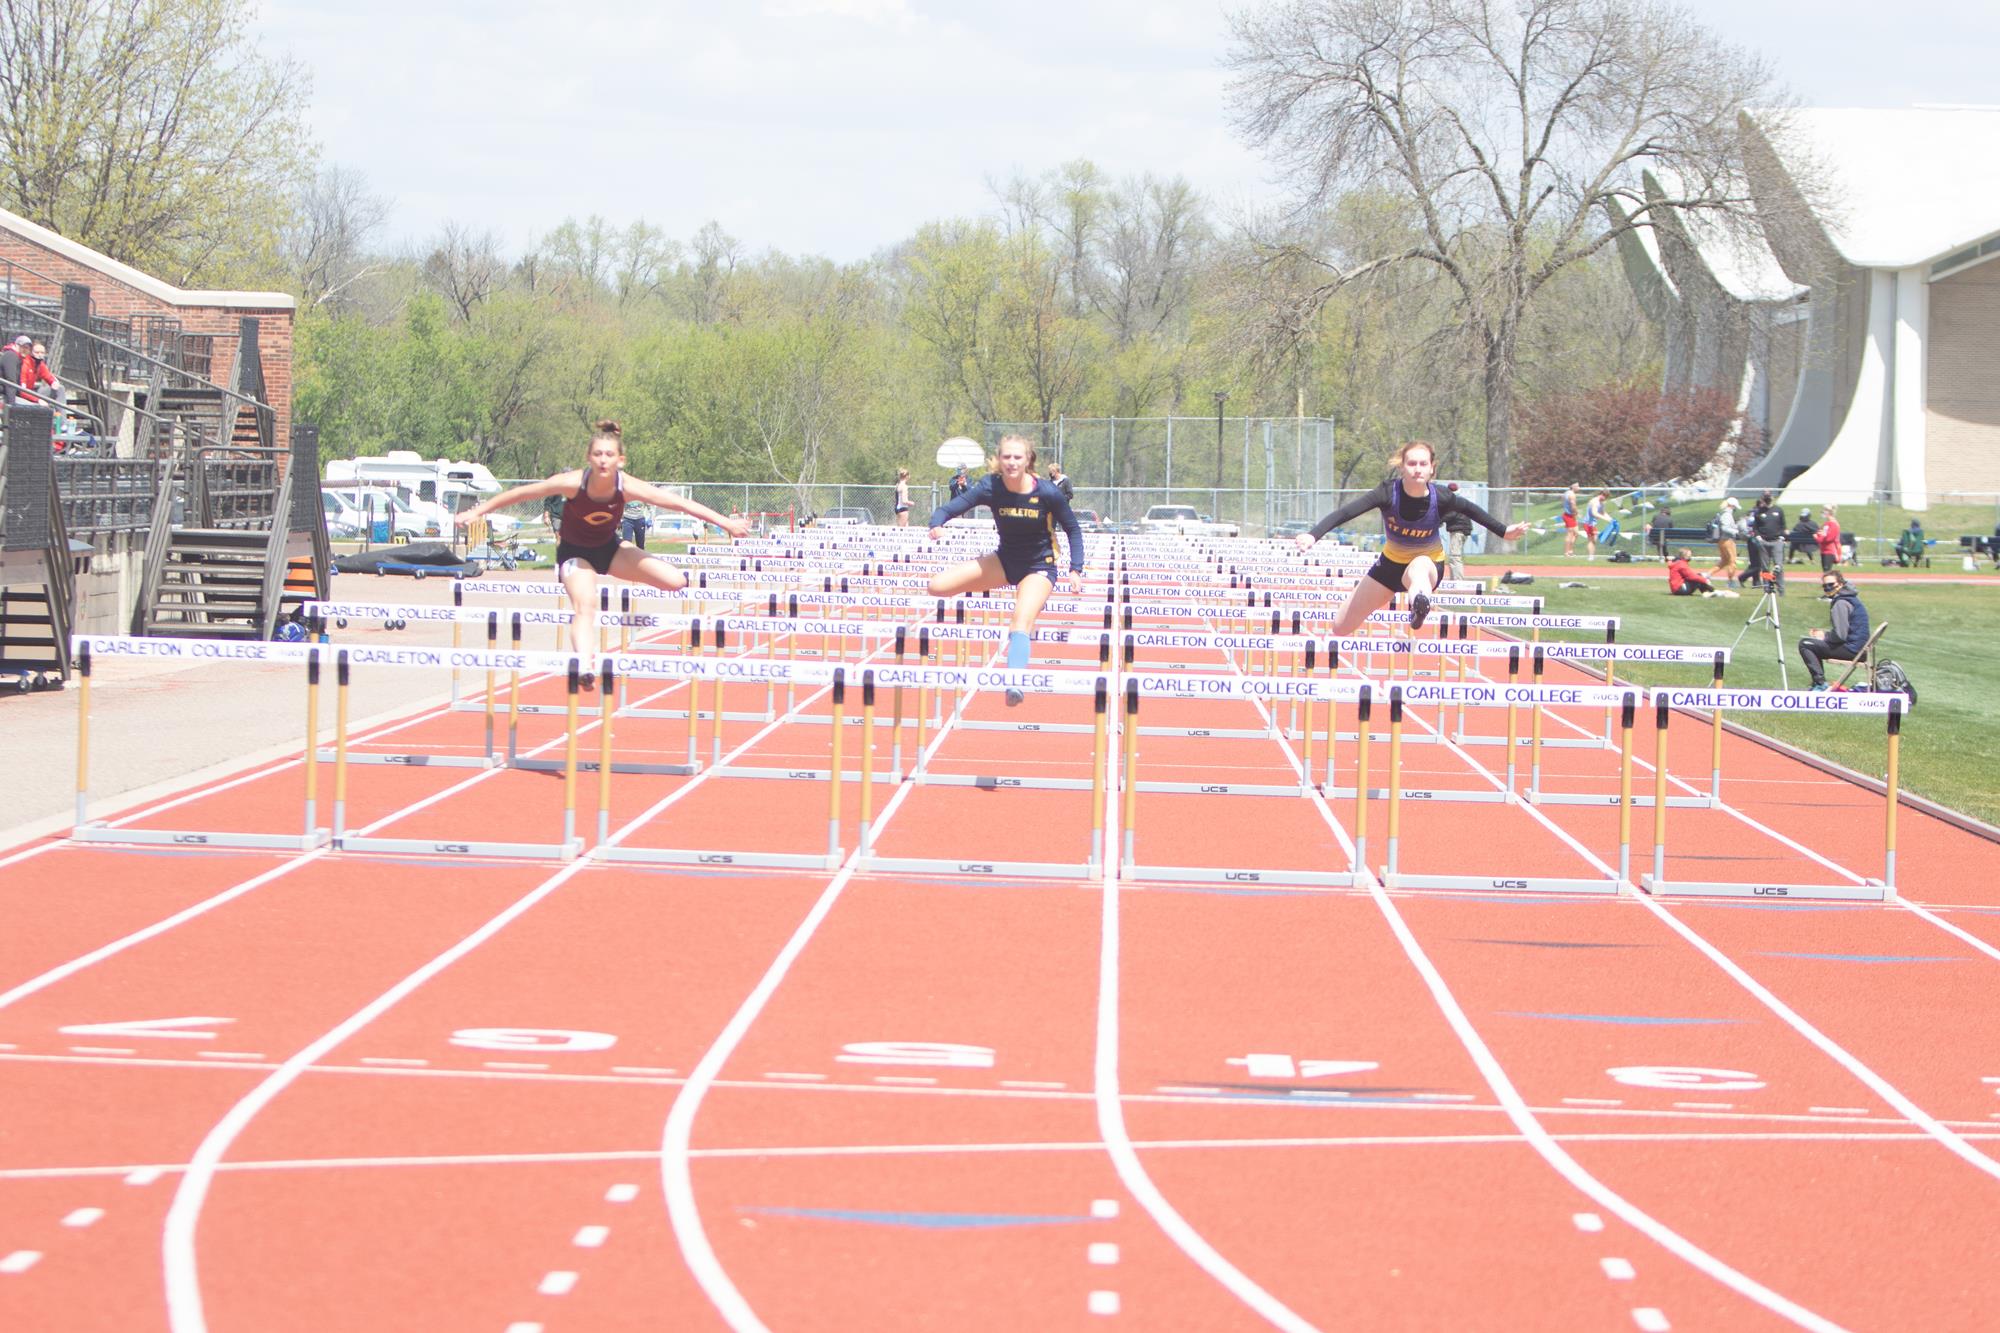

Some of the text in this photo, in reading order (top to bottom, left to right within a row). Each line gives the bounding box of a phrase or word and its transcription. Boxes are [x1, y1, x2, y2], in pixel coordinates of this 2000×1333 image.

[762, 560, 844, 569] CARLETON COLLEGE
[884, 564, 927, 572] CARLETON
[708, 572, 802, 583] CARLETON COLLEGE
[849, 577, 898, 587] CARLETON
[1130, 573, 1212, 583] CARLETON COLLEGE
[1252, 576, 1335, 586] CARLETON COLLEGE
[464, 583, 520, 593] CARLETON
[1132, 587, 1180, 597] CARLETON
[1185, 589, 1227, 598] COLLEGE
[632, 588, 688, 599] CARLETON
[694, 591, 743, 601] COLLEGE
[1272, 592, 1321, 601] CARLETON
[799, 594, 856, 605] CARLETON
[862, 597, 911, 607] COLLEGE
[966, 600, 1015, 611] CARLETO
[1430, 596, 1511, 606] RLETON COLLEGE
[321, 605, 389, 618] CARLETON
[398, 608, 456, 620] COLLEGE
[1134, 606, 1192, 617] CARLETON
[1197, 608, 1246, 618] COLLEGE
[524, 612, 575, 625] CARLET
[601, 615, 659, 627] COLLEGE
[1470, 615, 1526, 626] CARLETON
[1532, 617, 1581, 627] COLLEGE
[728, 620, 796, 632] CARLETON
[805, 622, 863, 635] COLLEGE
[932, 627, 1000, 640] CARLETON
[1031, 629, 1069, 642] LLEGE
[1137, 634, 1206, 647] CARLETON
[1214, 637, 1274, 649] COLLEGE
[1341, 640, 1411, 653] CARLETON
[1418, 642, 1478, 654] COLLEGE
[95, 640, 181, 656] CARLETON
[192, 645, 266, 659] COLLEGE
[1547, 645, 1616, 658] CARLETON
[1624, 648, 1683, 660] COLLEGE
[353, 649, 440, 665] CARLETON
[451, 653, 526, 668] COLLEGE
[618, 658, 705, 674] CARLETON
[716, 662, 791, 678] COLLEGE
[879, 668, 967, 685] CARLETON
[977, 672, 1053, 687] COLLEGE
[1142, 677, 1231, 693] CARLETON
[1241, 681, 1318, 696] COLLEGE
[1405, 685, 1495, 701] CARLETON
[1505, 688, 1582, 703] COLLEGE
[1672, 692, 1762, 707] CARLETON
[1771, 694, 1848, 709] COLLEGE
[585, 763, 600, 771] UC
[994, 778, 1021, 786] UCS
[174, 835, 207, 844] UCS
[435, 844, 469, 853] UCS
[699, 855, 733, 863] UCS
[959, 864, 993, 873] UCS
[1226, 873, 1260, 881] UCS
[1493, 880, 1527, 889] UCS
[1754, 888, 1788, 896] UCS
